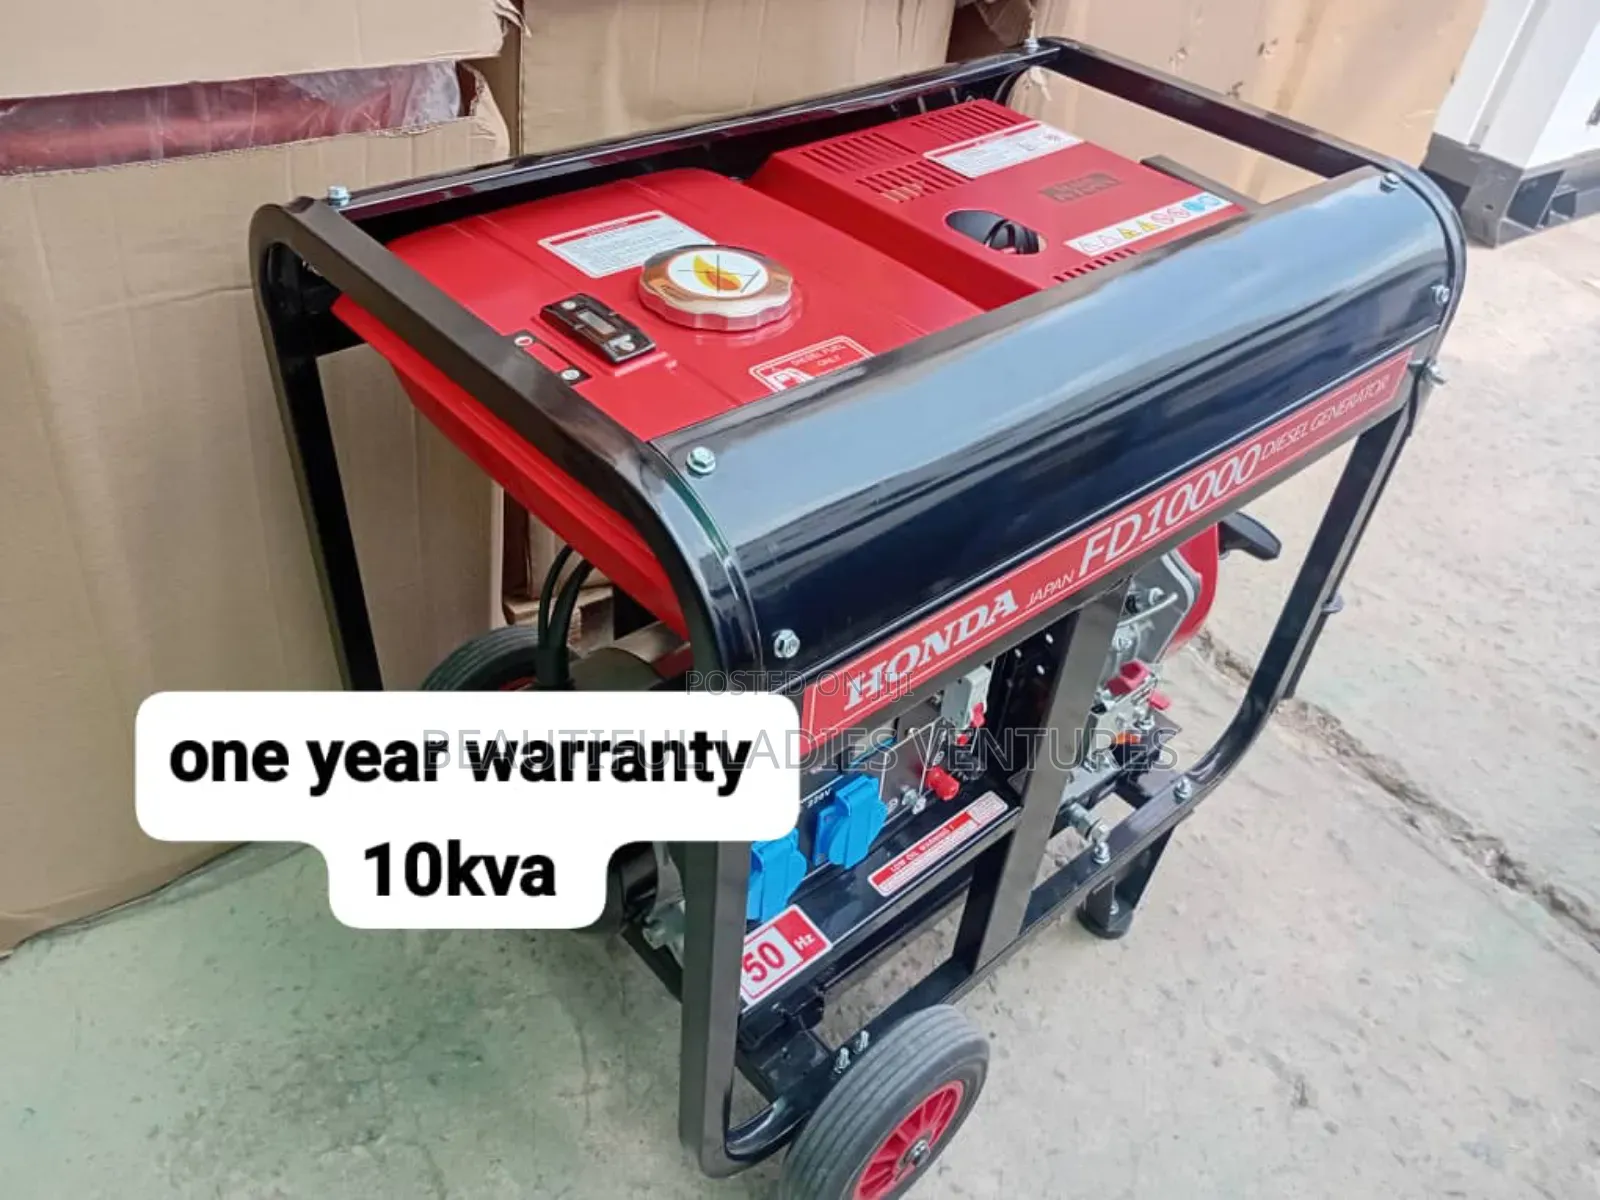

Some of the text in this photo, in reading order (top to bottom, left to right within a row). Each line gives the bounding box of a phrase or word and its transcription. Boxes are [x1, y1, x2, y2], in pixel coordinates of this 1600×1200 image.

[844, 373, 1391, 711] HONDA JAPAN FD10000 DIESEL GENERATOR
[742, 934, 816, 983] 50 Hz
